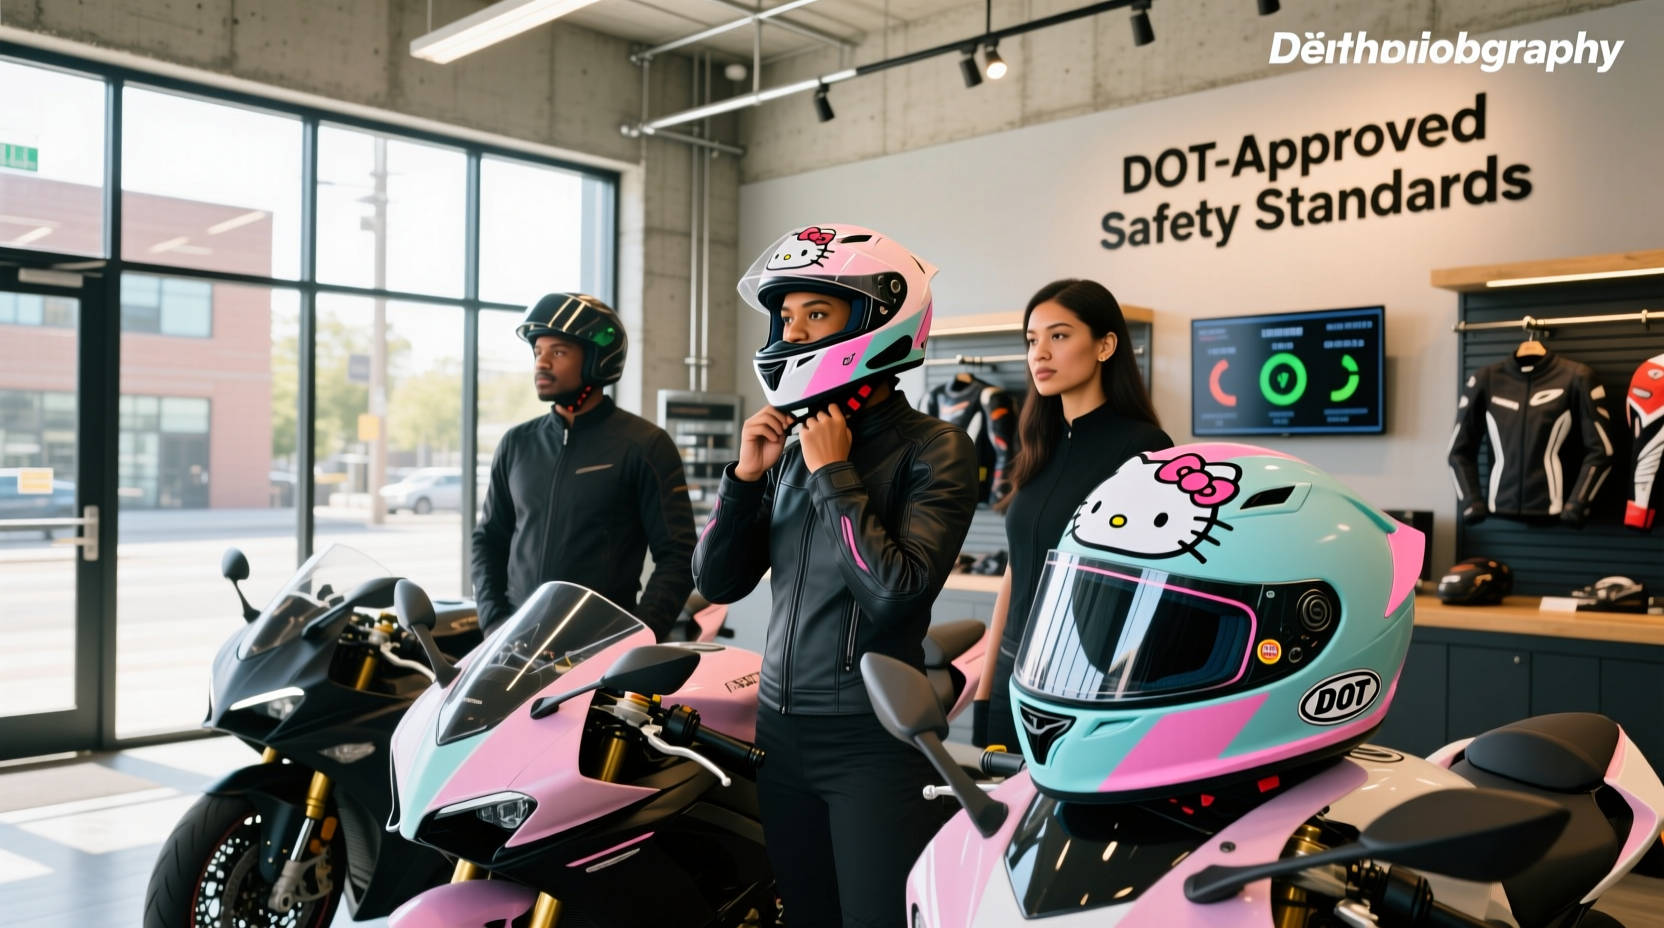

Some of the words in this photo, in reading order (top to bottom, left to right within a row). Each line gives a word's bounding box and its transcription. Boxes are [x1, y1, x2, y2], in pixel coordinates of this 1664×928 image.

[1123, 92, 1487, 194] DOT-Approved
[1100, 200, 1241, 250] Safety
[1255, 154, 1533, 230] Standards
[1314, 678, 1371, 715] DOT
